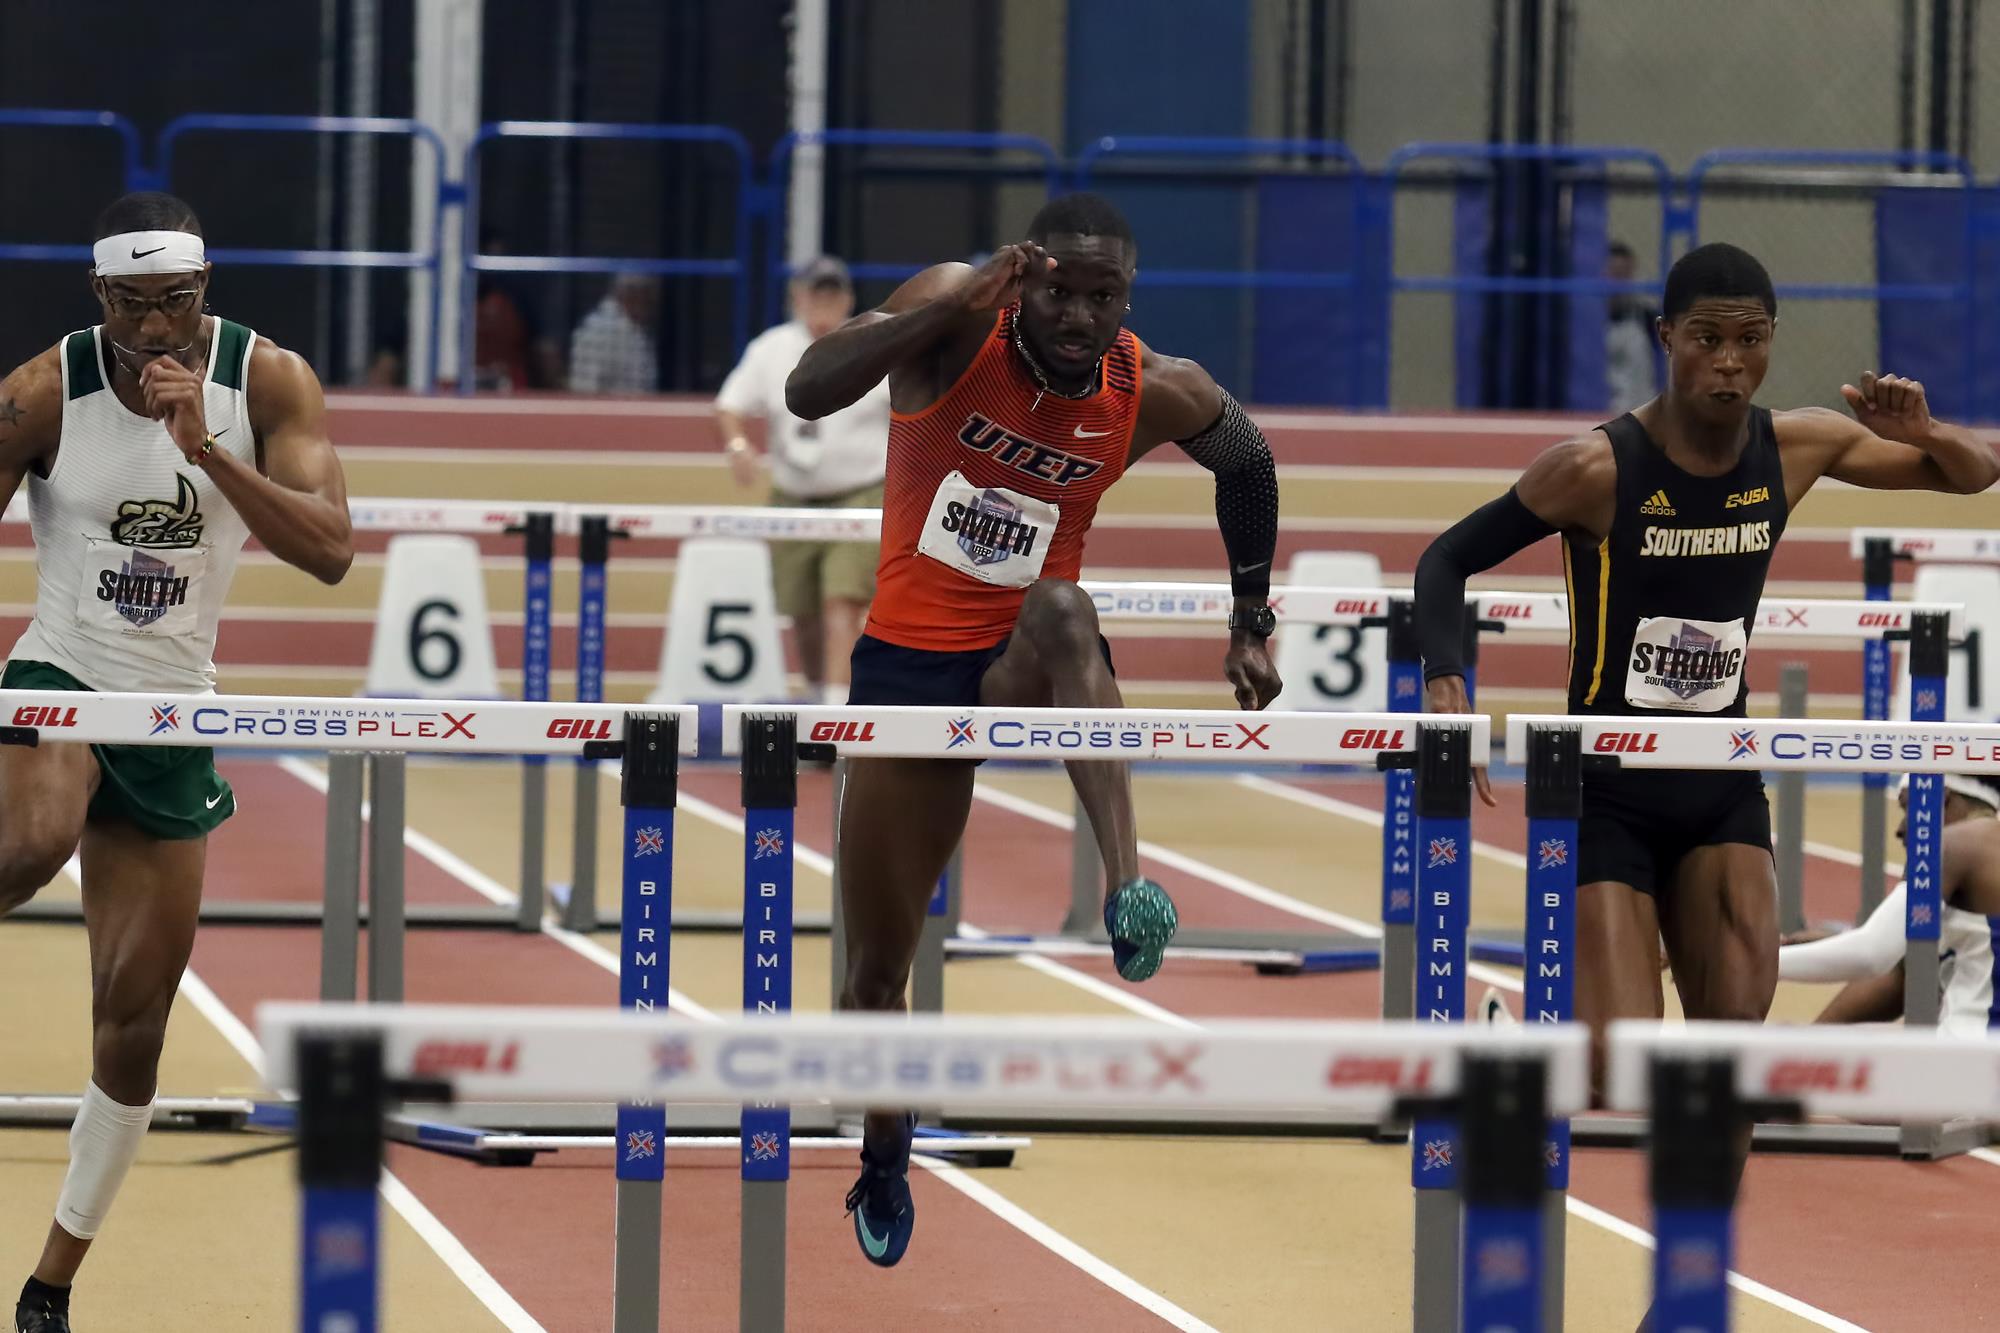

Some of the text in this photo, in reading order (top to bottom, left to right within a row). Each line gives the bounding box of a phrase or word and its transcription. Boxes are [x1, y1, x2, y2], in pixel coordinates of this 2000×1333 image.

[958, 412, 1104, 486] UTEP
[1640, 505, 1677, 516] adidas
[942, 501, 1038, 557] SMITH
[1639, 520, 1771, 557] SOUTHERN MISS
[97, 569, 189, 607] SMITH
[119, 605, 164, 617] CHARLOTTE
[1334, 600, 1379, 616] GILL
[1488, 602, 1533, 618] GILL
[1858, 612, 1903, 628] GILL
[408, 599, 461, 682] 6
[702, 604, 755, 684] 5
[1311, 624, 1366, 699] 3
[1632, 642, 1741, 681] STRONG
[1949, 627, 1981, 709] 1
[12, 706, 78, 727] GILL
[277, 708, 395, 718] BIRMINGHAM
[546, 719, 612, 739] GILL
[809, 721, 876, 742] GILL
[1072, 721, 1190, 731] BIRMINGHAM
[1339, 729, 1405, 750] GILL
[1593, 732, 1659, 753] GILL
[1853, 733, 1970, 742] BIRMINGHAM
[1430, 891, 1452, 1024] BIRMIN
[1539, 892, 1561, 1025] BIRMIN
